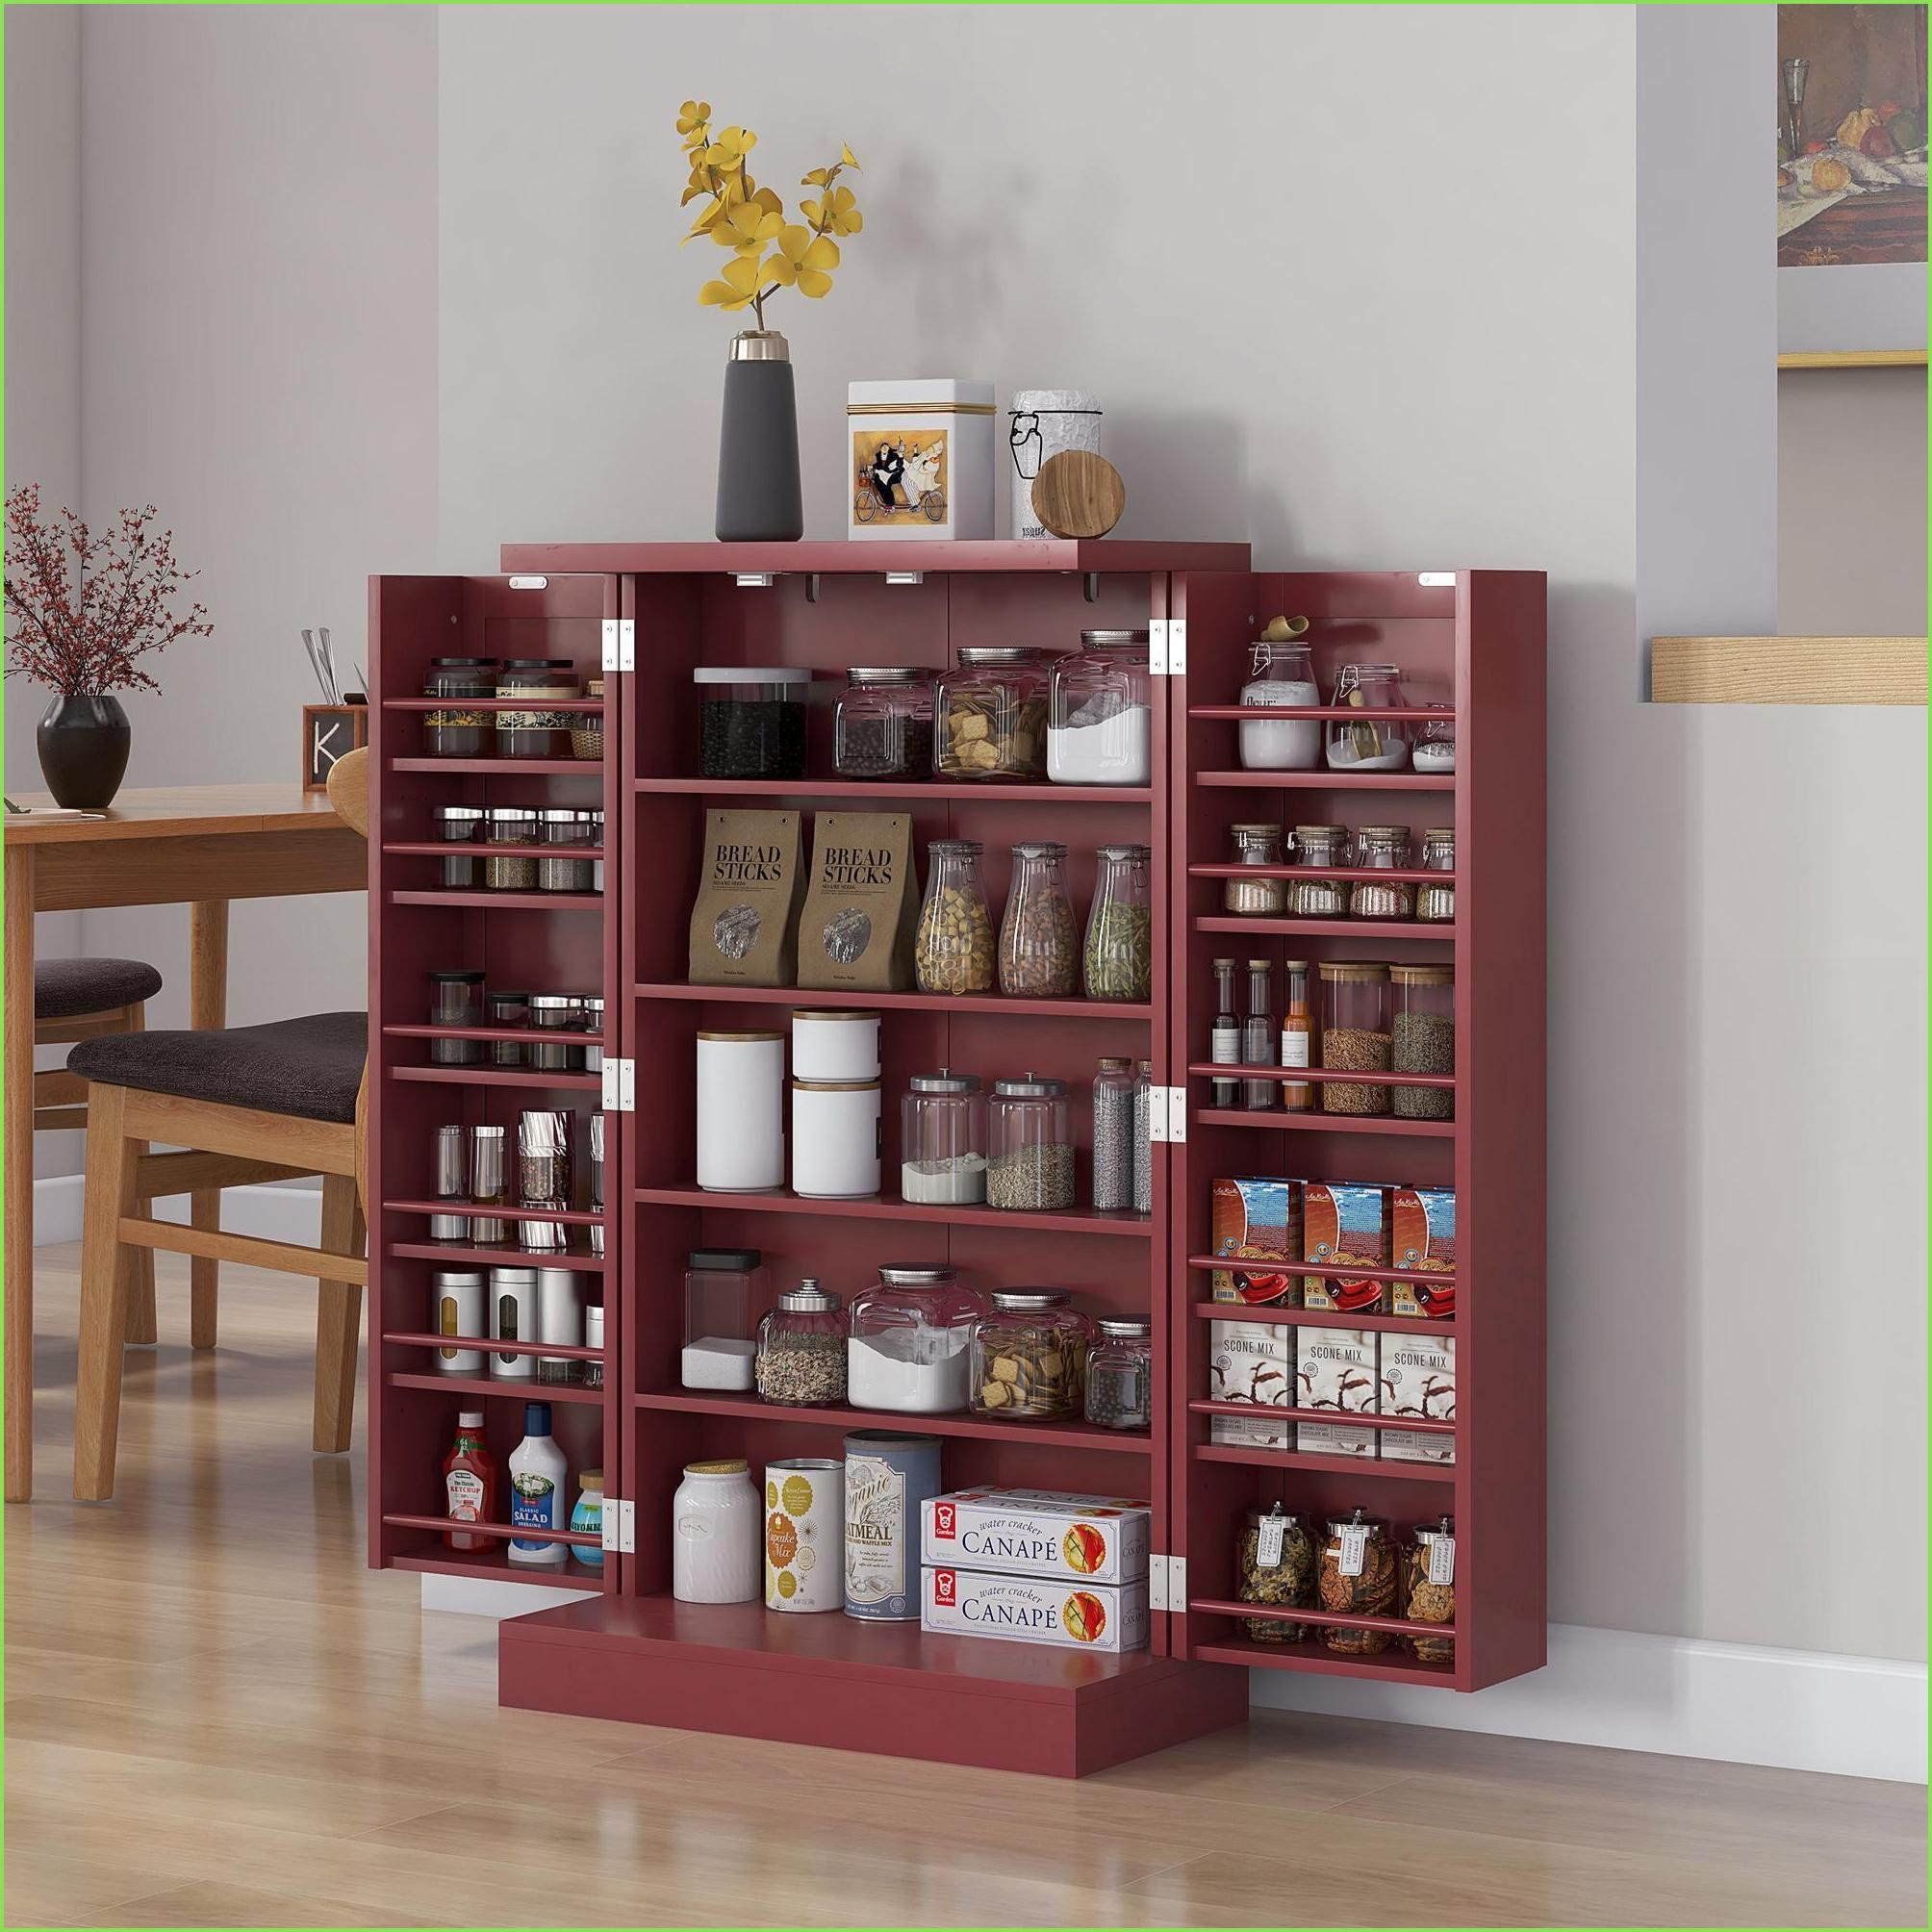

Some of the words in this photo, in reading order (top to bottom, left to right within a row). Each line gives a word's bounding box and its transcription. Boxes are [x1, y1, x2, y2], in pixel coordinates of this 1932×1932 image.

[314, 721, 340, 774] K
[716, 845, 781, 863] BREAD
[825, 848, 891, 866] BREAD
[714, 862, 781, 880] STICKS
[823, 865, 892, 884] STICKS
[1224, 1339, 1254, 1353] SCONE
[1258, 1342, 1274, 1355] MIX
[1310, 1347, 1341, 1360] SCONE
[1345, 1349, 1362, 1361] MIX
[1394, 1353, 1425, 1366] SCONE
[1429, 1355, 1446, 1368] MIX
[514, 1511, 548, 1523] SALAD
[979, 1519, 1006, 1531] water
[1008, 1520, 1043, 1537] cracker
[962, 1531, 1058, 1562] CANAPÉ
[979, 1587, 1006, 1598] water
[1008, 1588, 1043, 1604] cracker
[962, 1598, 1058, 1629] CANAPÉ
